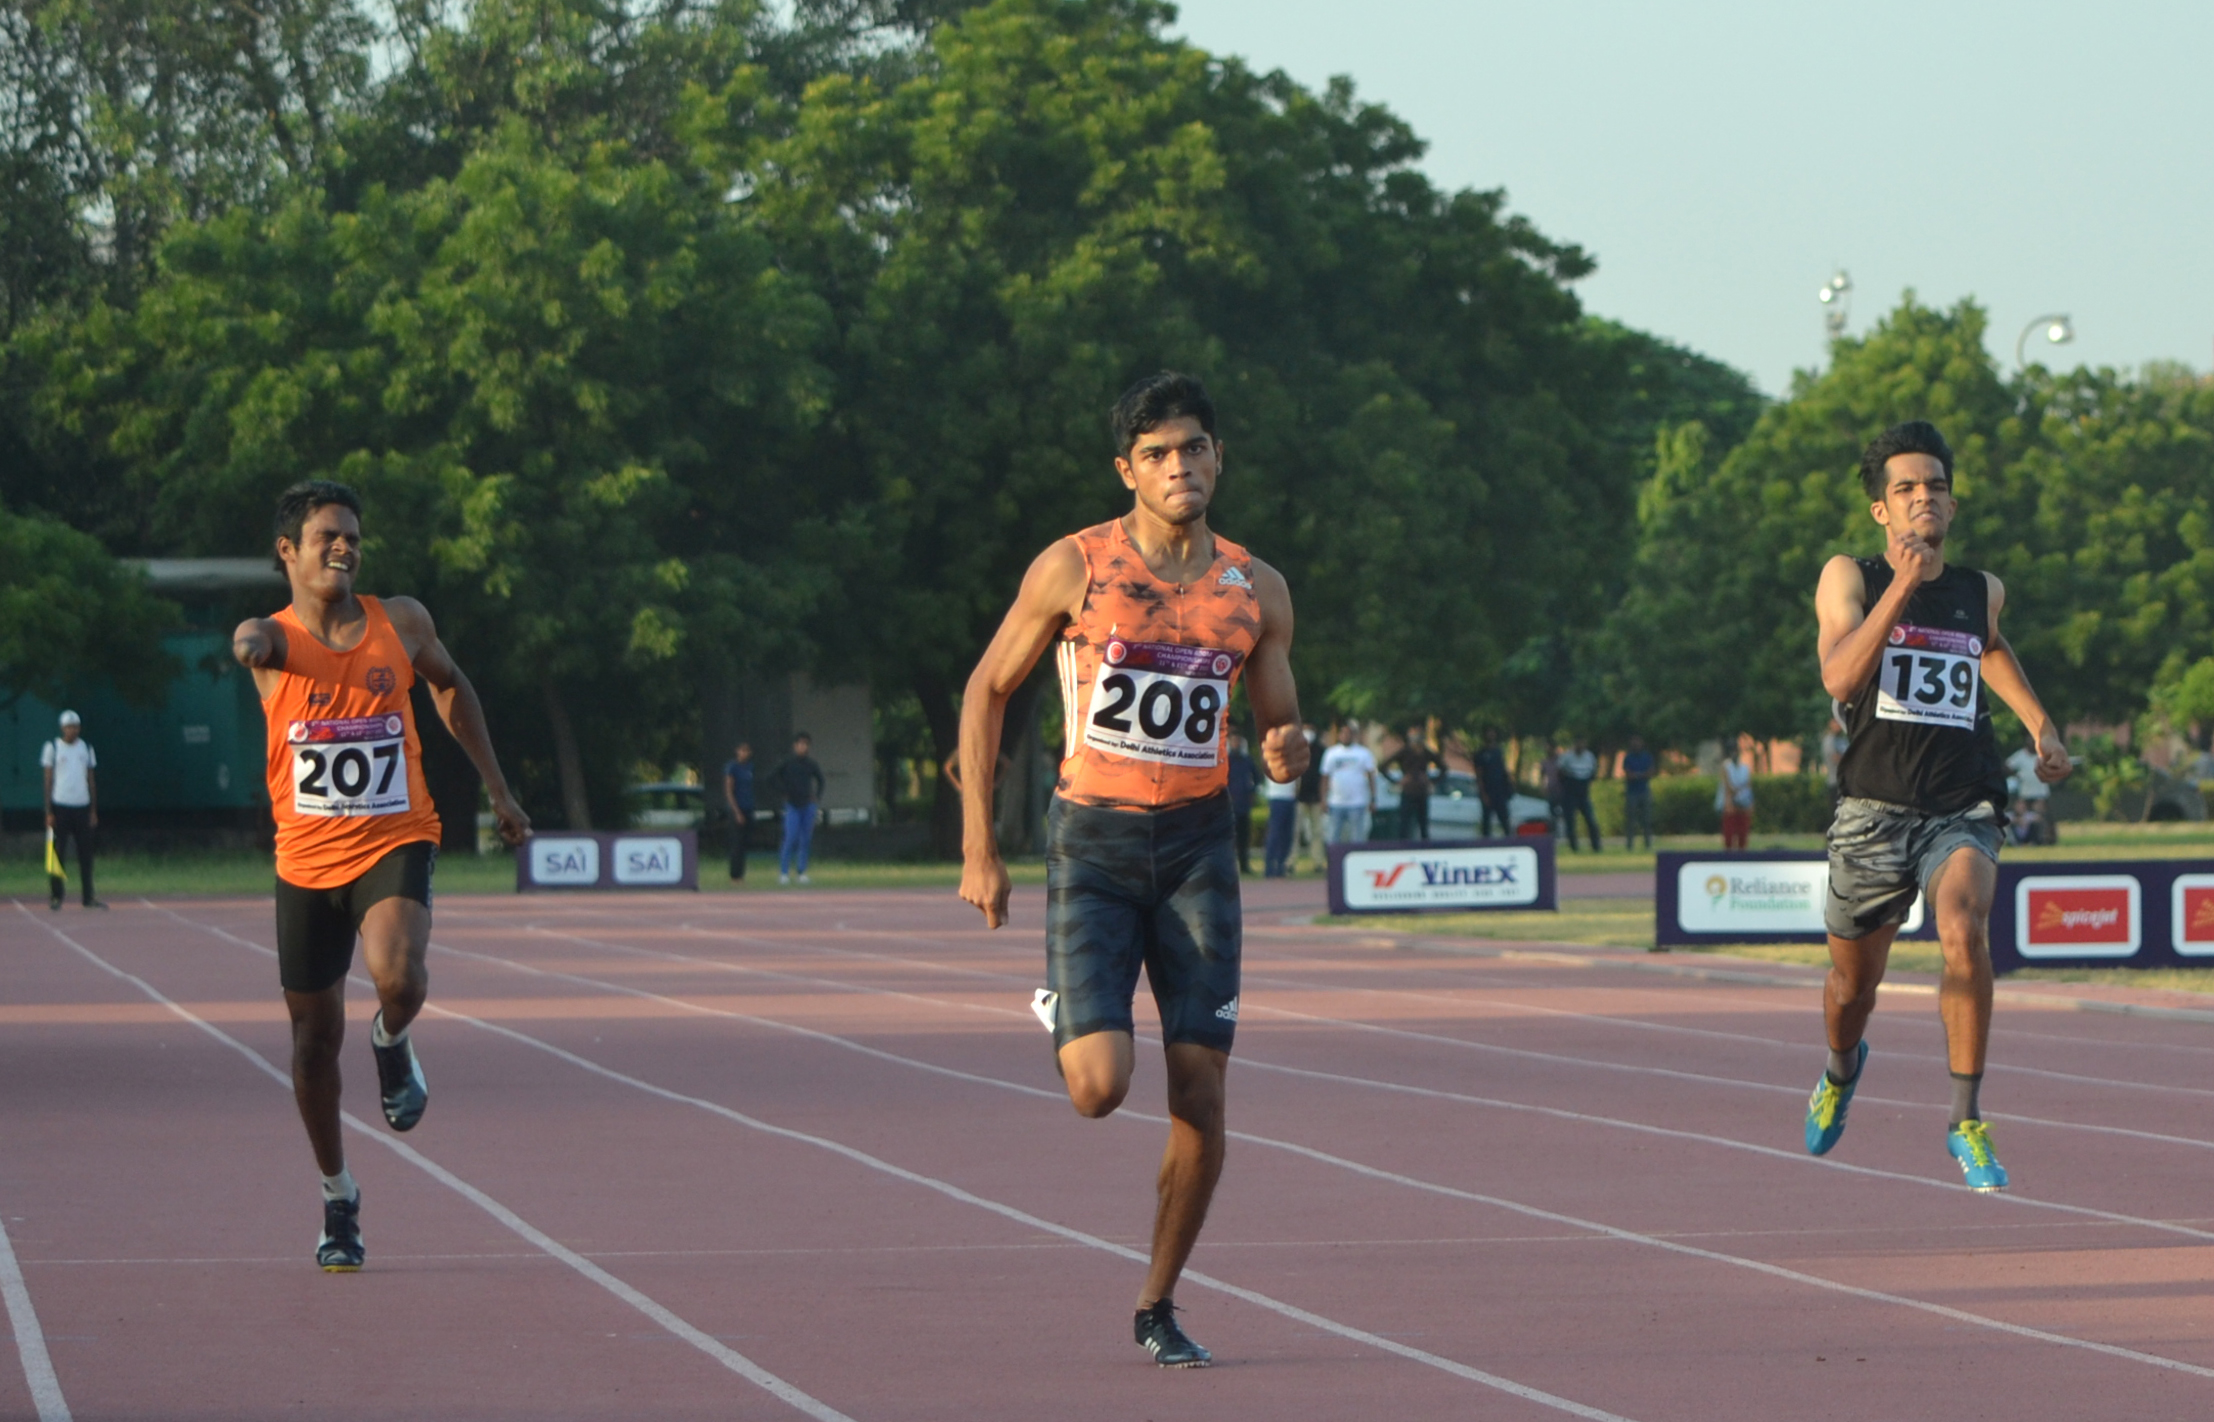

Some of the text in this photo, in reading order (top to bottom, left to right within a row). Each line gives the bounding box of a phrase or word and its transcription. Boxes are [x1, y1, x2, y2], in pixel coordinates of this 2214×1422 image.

[1891, 654, 1973, 709] 139
[1093, 673, 1221, 744] 208
[1120, 740, 1140, 753] Delhi
[1141, 744, 1176, 758] Athletics
[1178, 750, 1215, 761] Association
[299, 743, 400, 798] 207
[546, 851, 587, 873] SAI
[628, 851, 670, 873] SAI
[1421, 861, 1519, 886] Vinex
[1730, 876, 1812, 895] Reliance
[1730, 895, 1812, 911] Foundation
[2061, 907, 2119, 930] spicejet
